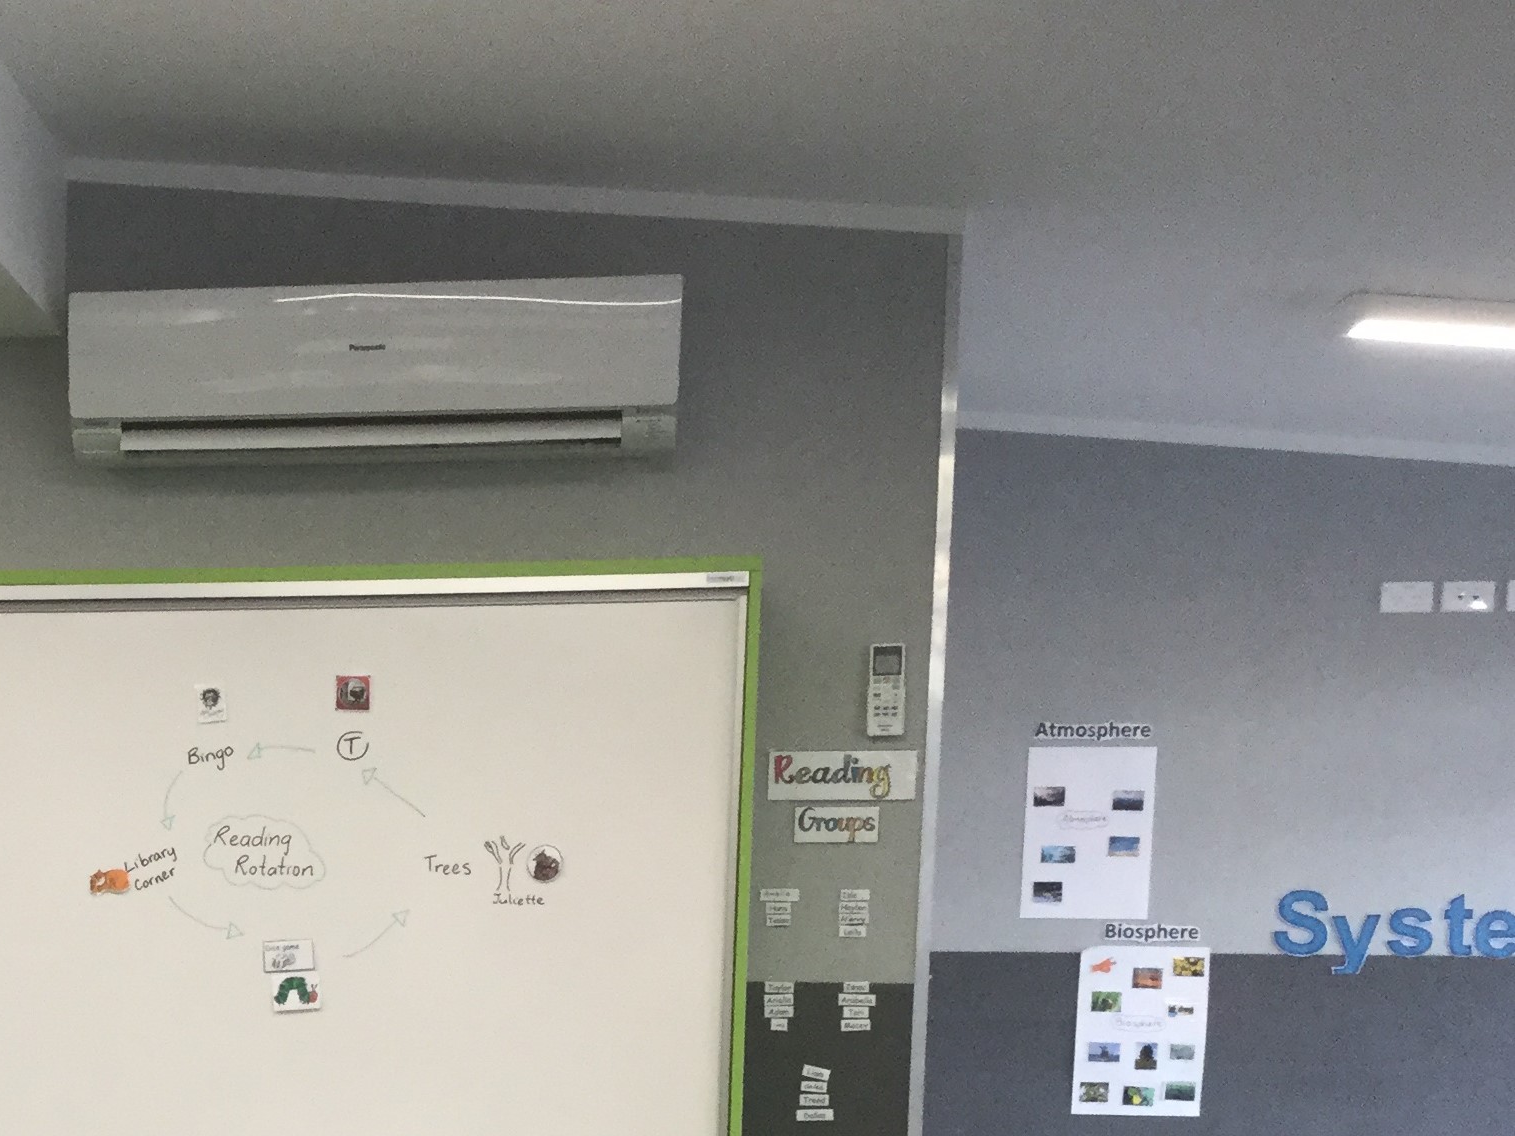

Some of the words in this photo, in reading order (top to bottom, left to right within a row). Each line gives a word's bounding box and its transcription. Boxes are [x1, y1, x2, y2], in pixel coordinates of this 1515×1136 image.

[1034, 721, 1152, 741] Atmosphere
[187, 746, 235, 771] Bingo
[773, 754, 891, 799] Reading
[797, 806, 877, 842] Groups
[213, 825, 293, 855] Reading
[124, 847, 178, 873] Library
[235, 854, 315, 877] Rotation
[423, 854, 472, 876] Trees
[493, 893, 545, 906] Juliette
[1105, 923, 1199, 942] Biosphere
